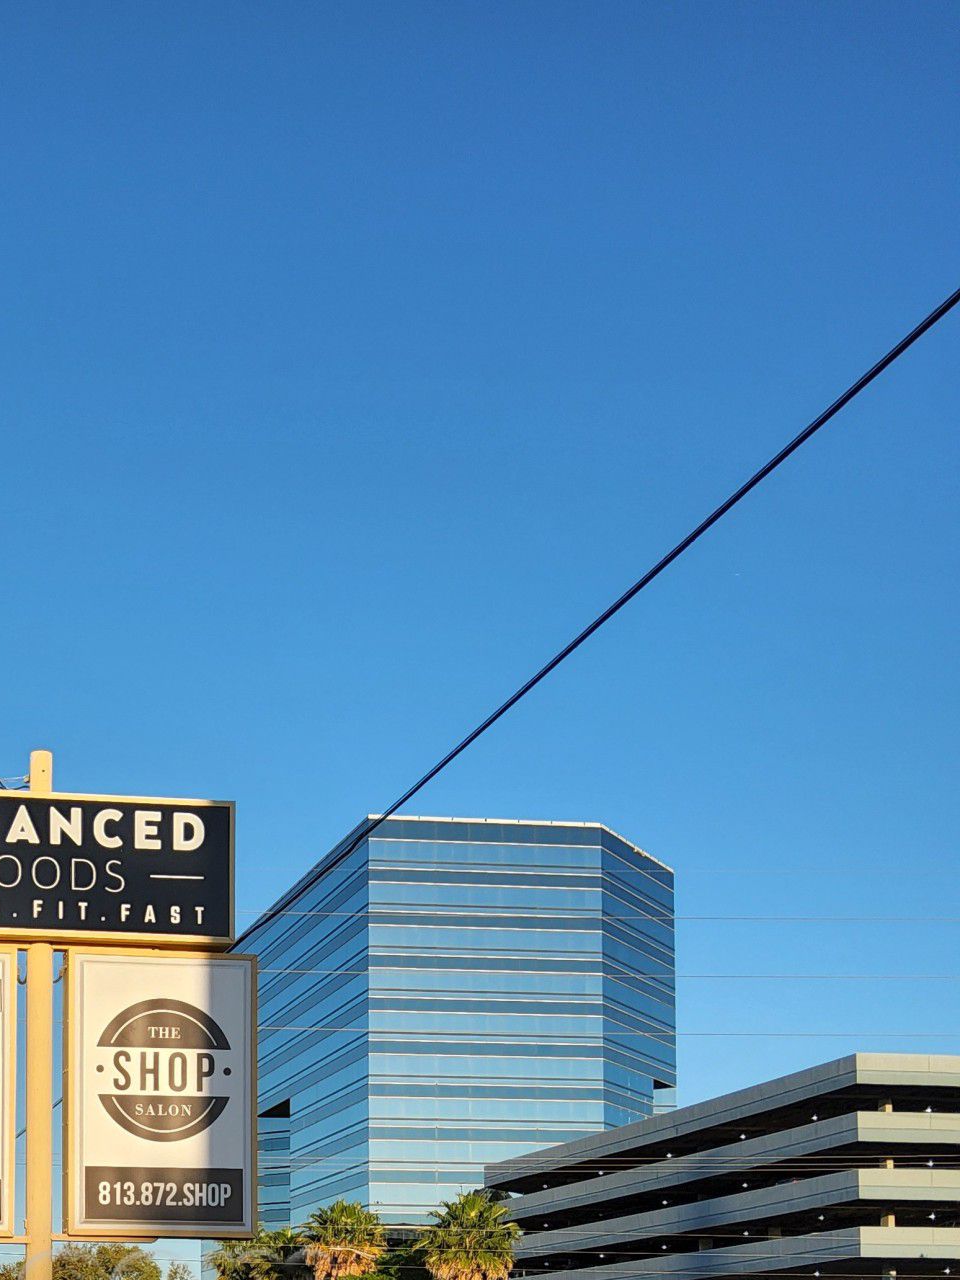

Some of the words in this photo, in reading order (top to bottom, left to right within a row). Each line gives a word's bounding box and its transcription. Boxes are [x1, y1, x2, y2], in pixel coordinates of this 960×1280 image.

[148, 1026, 181, 1039] THE
[113, 1050, 215, 1092] SHOP
[135, 1103, 193, 1117] SALON
[98, 1181, 233, 1207] 813.872.SHOP
